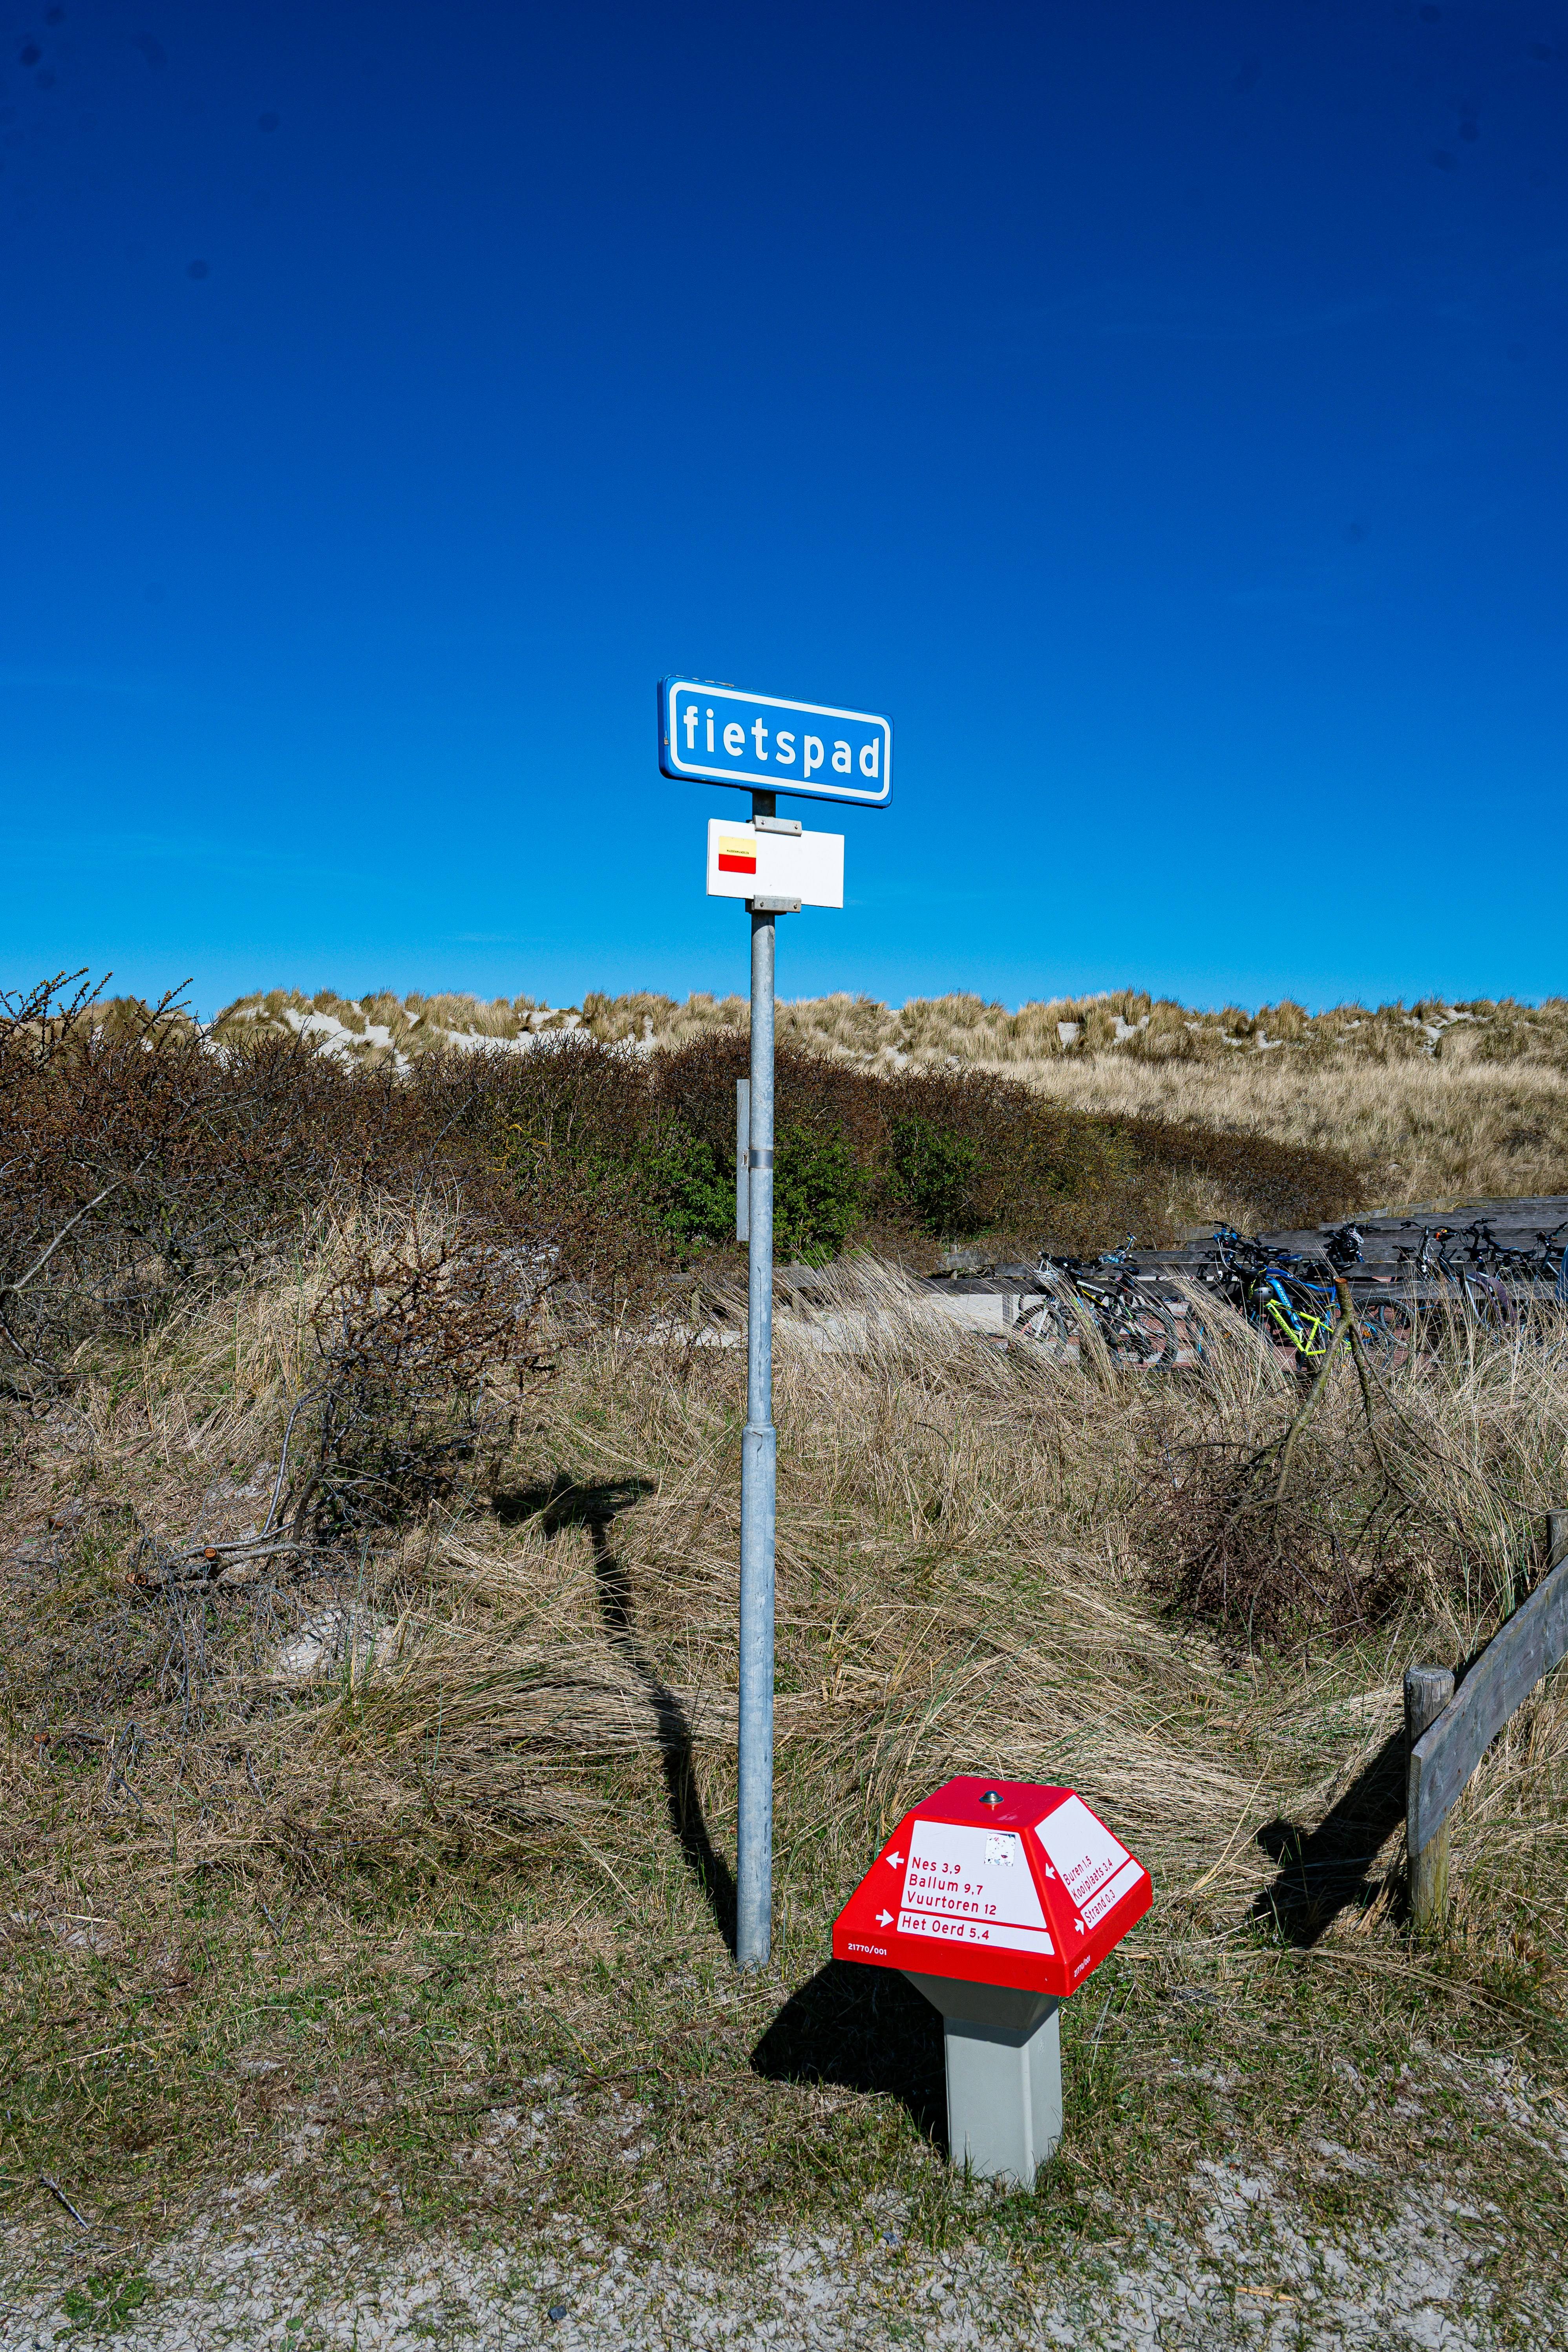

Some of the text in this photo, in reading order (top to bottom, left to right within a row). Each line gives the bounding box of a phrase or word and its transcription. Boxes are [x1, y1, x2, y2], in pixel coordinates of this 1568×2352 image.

[683, 705, 879, 779] fietspad
[1277, 1316, 1299, 1344] ROCKRIDER
[912, 1857, 961, 1874] Nes 3,9
[1063, 1855, 1091, 1886] Buren 1,5
[909, 1873, 983, 1895] Ballum 9,7
[1071, 1858, 1113, 1901] Kooiplaats 3,4
[907, 1890, 996, 1915] Vuurtoren 12
[1084, 1889, 1115, 1923] Strand 0,3
[902, 1915, 989, 1940] Het Oerd 5,4
[848, 1943, 887, 1955] 21770/001
[1074, 1955, 1091, 1977] 21770/001
